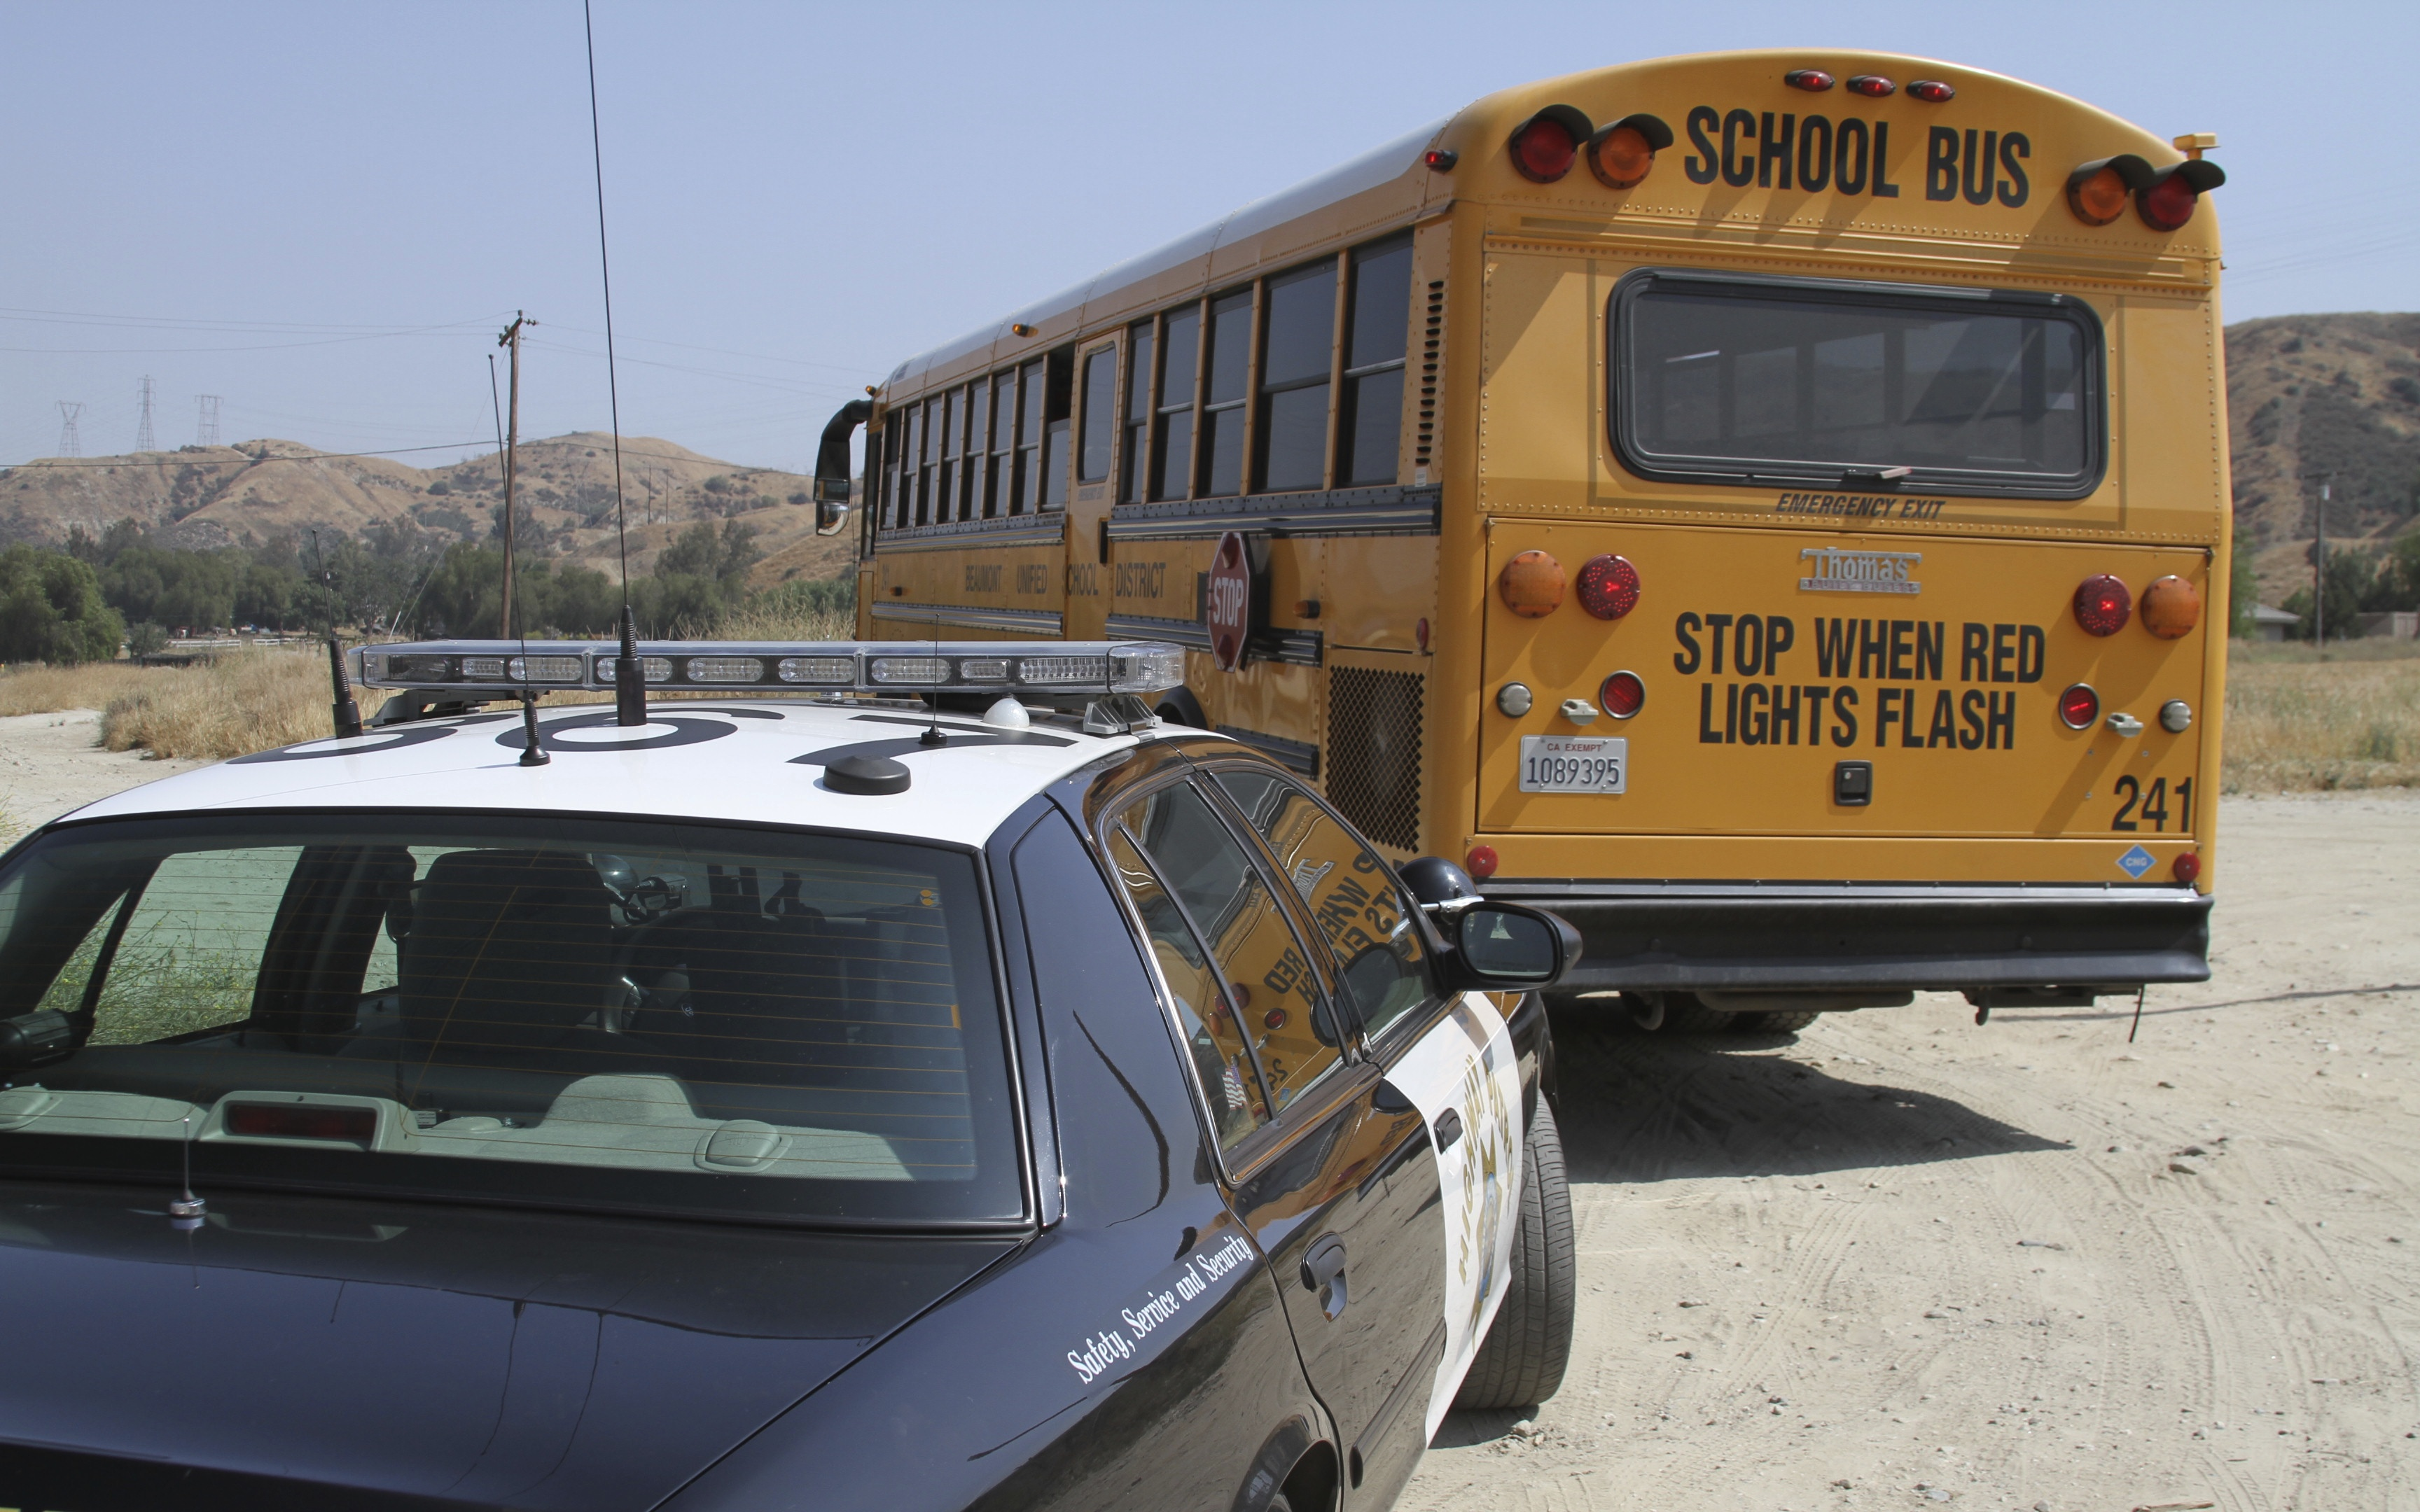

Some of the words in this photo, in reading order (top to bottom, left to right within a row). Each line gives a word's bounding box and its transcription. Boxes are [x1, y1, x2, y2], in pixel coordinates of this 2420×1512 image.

[1684, 105, 1898, 198] SCHOOL
[1926, 125, 2031, 208] BUS
[1775, 493, 1897, 517] EMERGENCY
[1900, 499, 1946, 519] EXIT
[1017, 564, 1048, 594] UNIFIED
[1062, 563, 1099, 596] SCHOOL
[1116, 561, 1166, 598] DISTRICT
[1801, 547, 1921, 582] Thomas
[1213, 577, 1244, 627] STOP
[1674, 611, 1795, 676] STOP
[1814, 617, 1945, 681] WHEN
[1961, 622, 2045, 684] RED
[1699, 682, 1859, 748] LIGHTS
[1875, 687, 2016, 750] FLASH
[1547, 743, 1560, 752] CA
[1565, 743, 1602, 752] EXEMPT
[1527, 757, 1620, 785] 1089395
[2111, 774, 2192, 833] 241
[2125, 857, 2148, 867] CNG
[1067, 1331, 1136, 1384] Safety,
[1121, 1291, 1180, 1340] Service
[1176, 1263, 1206, 1301] and
[1196, 1235, 1254, 1282] Security
